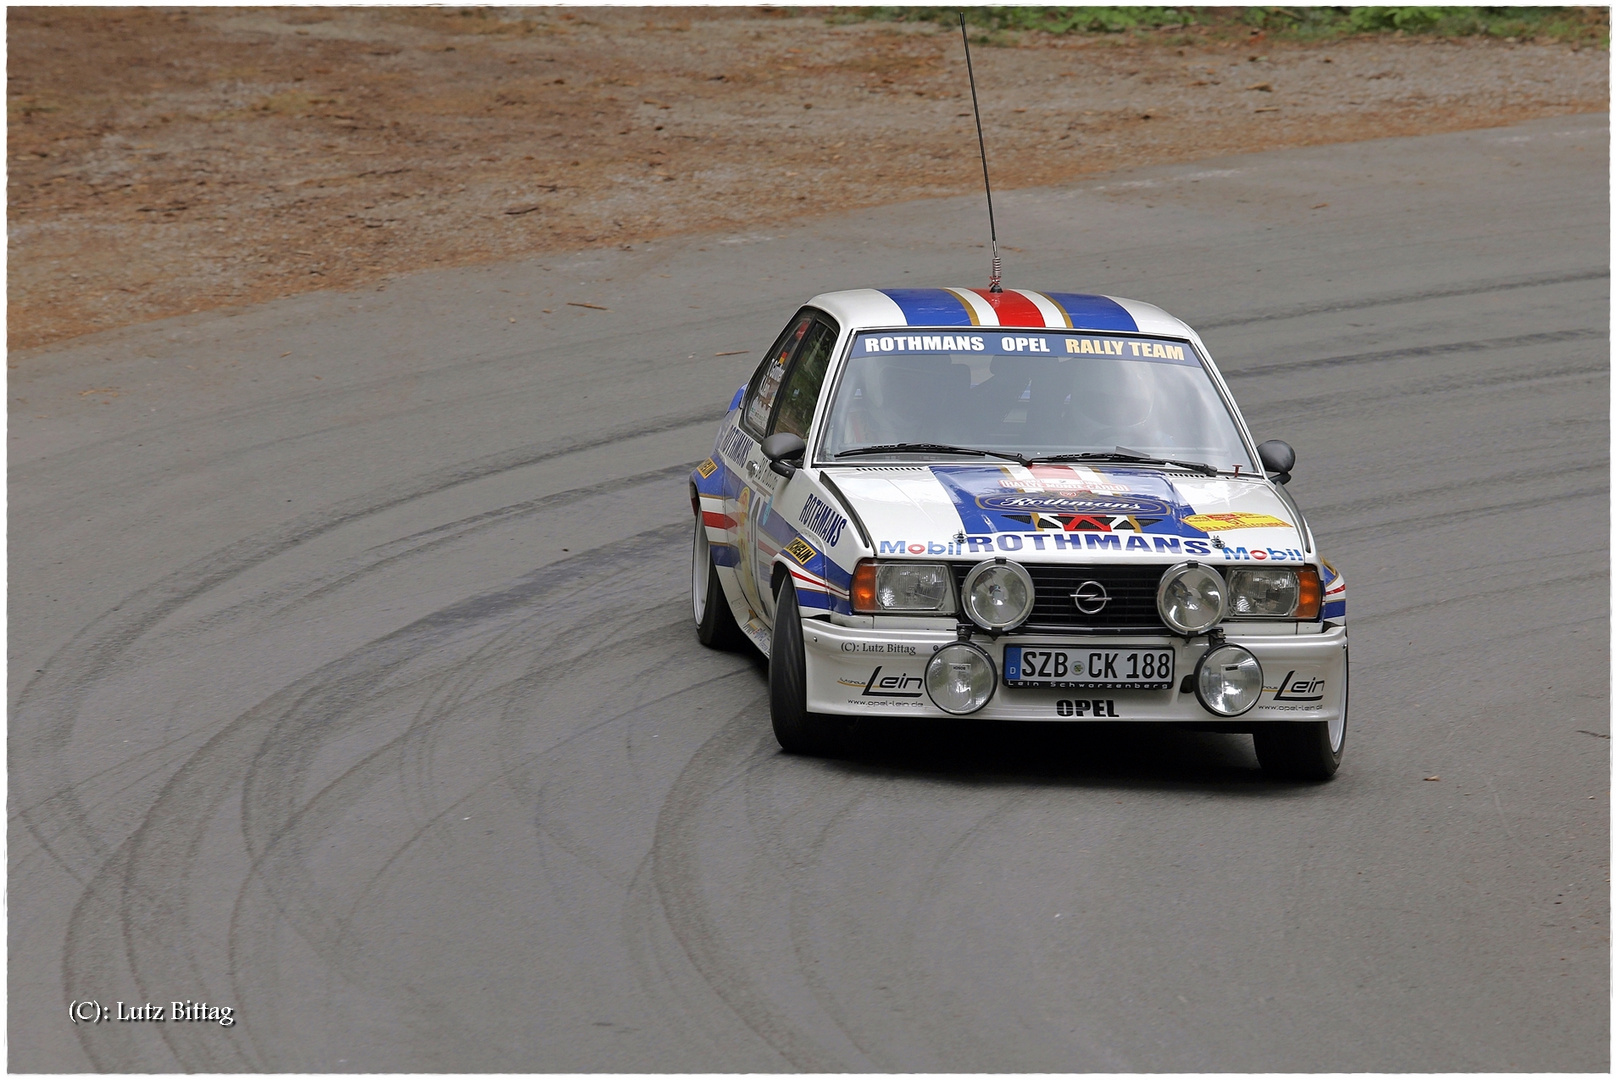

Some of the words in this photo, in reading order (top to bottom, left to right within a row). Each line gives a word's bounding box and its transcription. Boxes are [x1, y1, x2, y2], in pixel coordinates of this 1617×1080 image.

[864, 336, 985, 352] ROTHMANS
[1001, 337, 1050, 352] OPEL
[1065, 338, 1123, 356] RALLY
[1128, 341, 1185, 361] TEAM
[1000, 497, 1142, 510] Rothmans
[799, 493, 847, 548] ROTHMANS
[880, 540, 961, 556] Mobil
[966, 533, 1211, 556] ROTHMANS
[1222, 547, 1303, 561] Mobil
[1022, 651, 1068, 677] SZB
[1088, 652, 1118, 678] CK
[1126, 653, 1170, 679] 188
[862, 666, 923, 697] Lein
[1008, 679, 1039, 687] Lein
[1050, 681, 1168, 689] Schwarzenberg
[1273, 670, 1325, 701] Lein
[848, 699, 923, 708] www.opel-lein.de
[1056, 700, 1120, 717] OPEL
